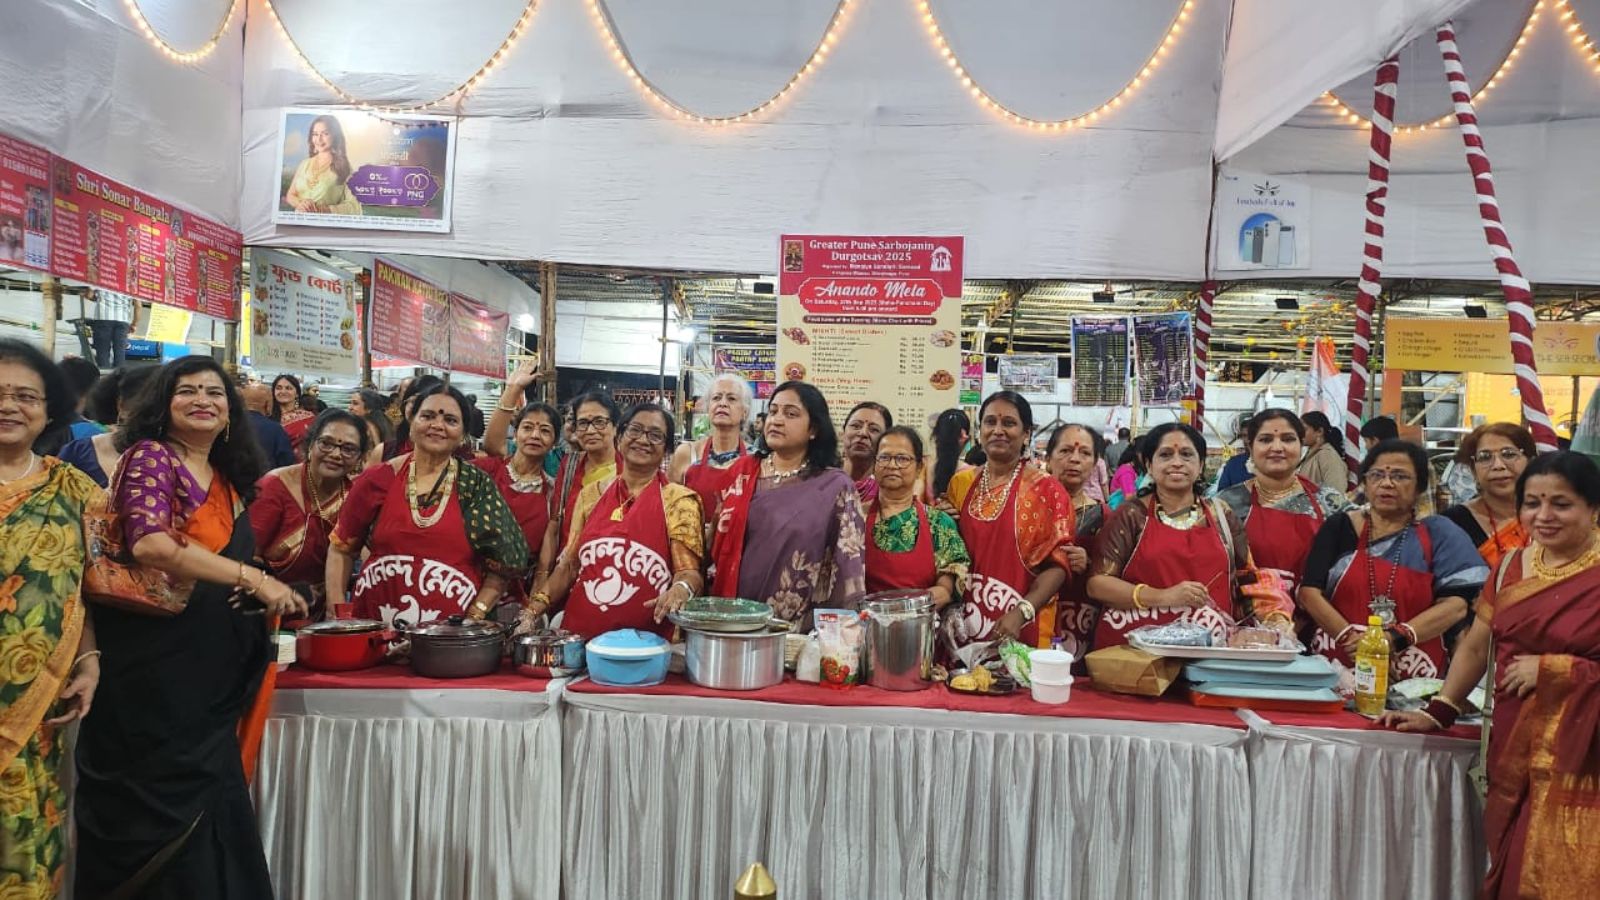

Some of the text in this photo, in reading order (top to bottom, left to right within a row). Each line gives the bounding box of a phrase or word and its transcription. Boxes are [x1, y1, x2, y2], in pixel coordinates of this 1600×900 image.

[76, 173, 170, 223] Shri Sonar Bangala
[407, 190, 425, 199] PNG
[809, 239, 935, 251] Greater Pune Sarbojanin
[831, 252, 912, 263] Durgotsav 2025
[813, 280, 926, 298] Anando Mela
[355, 555, 477, 611] আনন্দ মেলা
